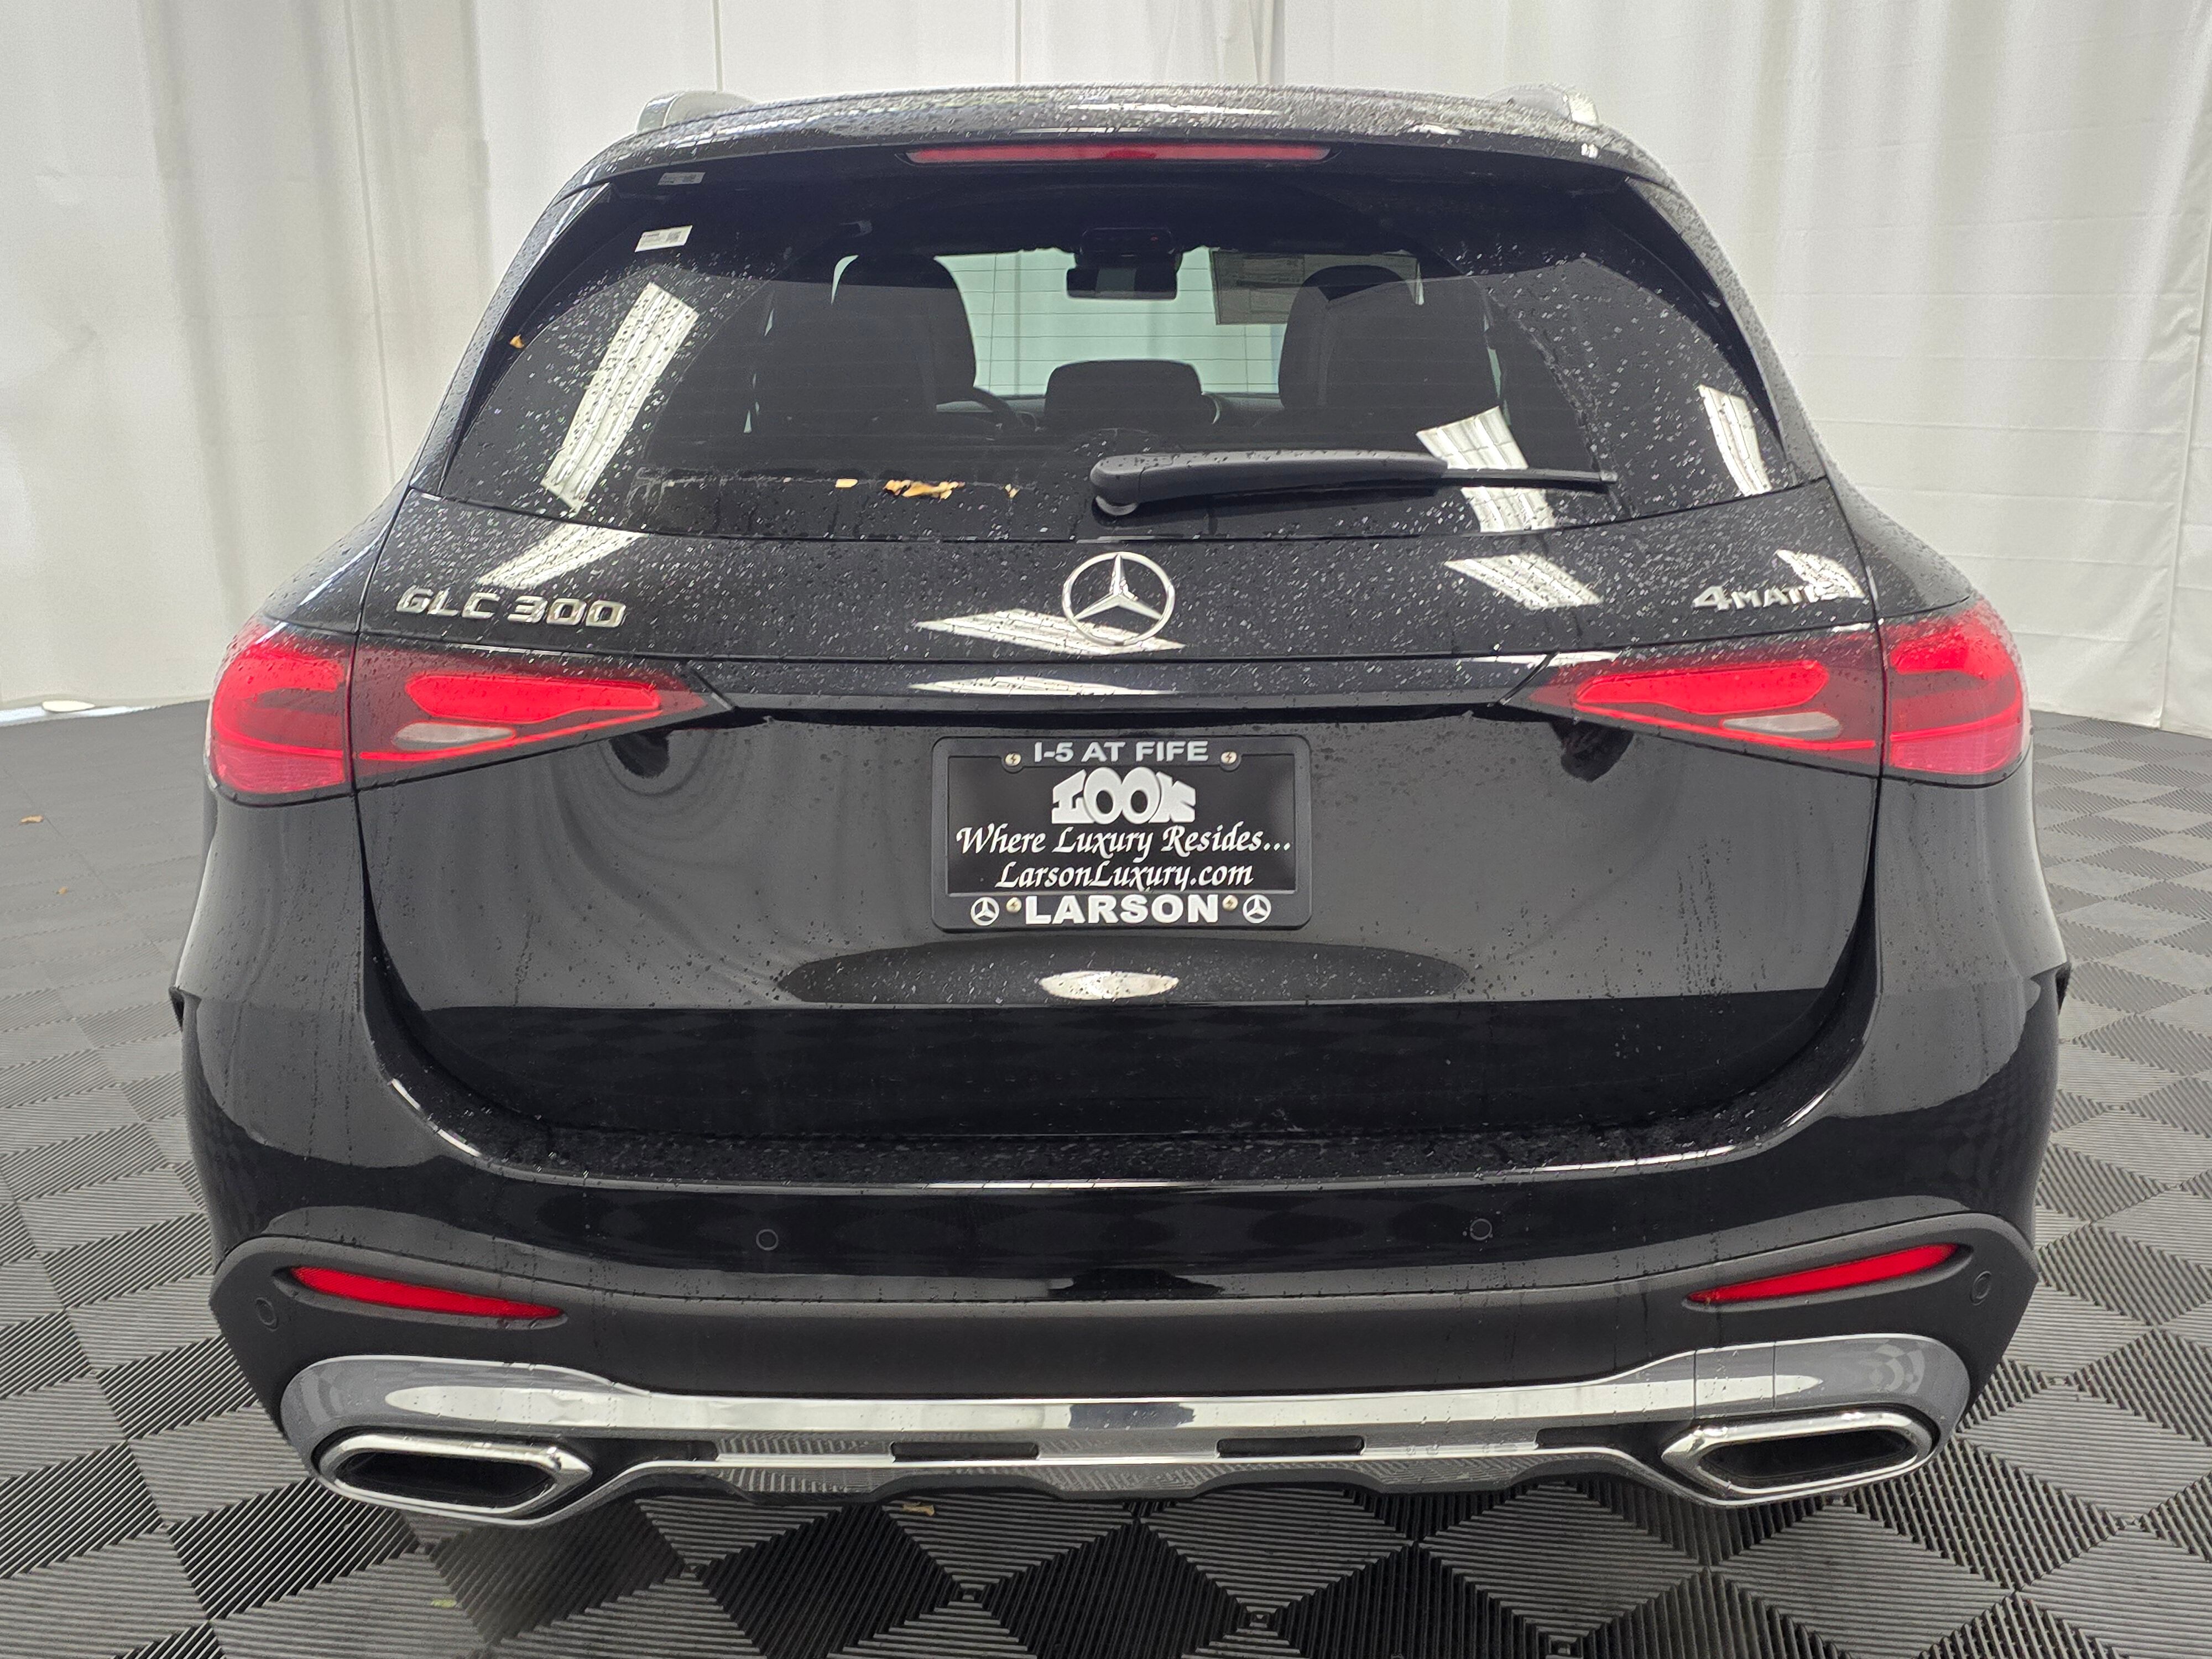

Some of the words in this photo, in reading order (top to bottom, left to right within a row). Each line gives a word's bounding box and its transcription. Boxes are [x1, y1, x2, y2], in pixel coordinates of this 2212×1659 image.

[396, 587, 500, 619] GLC
[507, 596, 627, 628] 300
[1034, 741, 1073, 763] I-5
[1081, 742, 1126, 762] AT
[1136, 740, 1209, 761] FIFE
[1051, 766, 1196, 825] LOOK
[955, 823, 1046, 854] Where
[1052, 826, 1155, 863] Luxury
[1162, 821, 1292, 858] Resides...
[994, 860, 1254, 893] LarsonLuxury.com
[1025, 894, 1219, 926] LARSON
